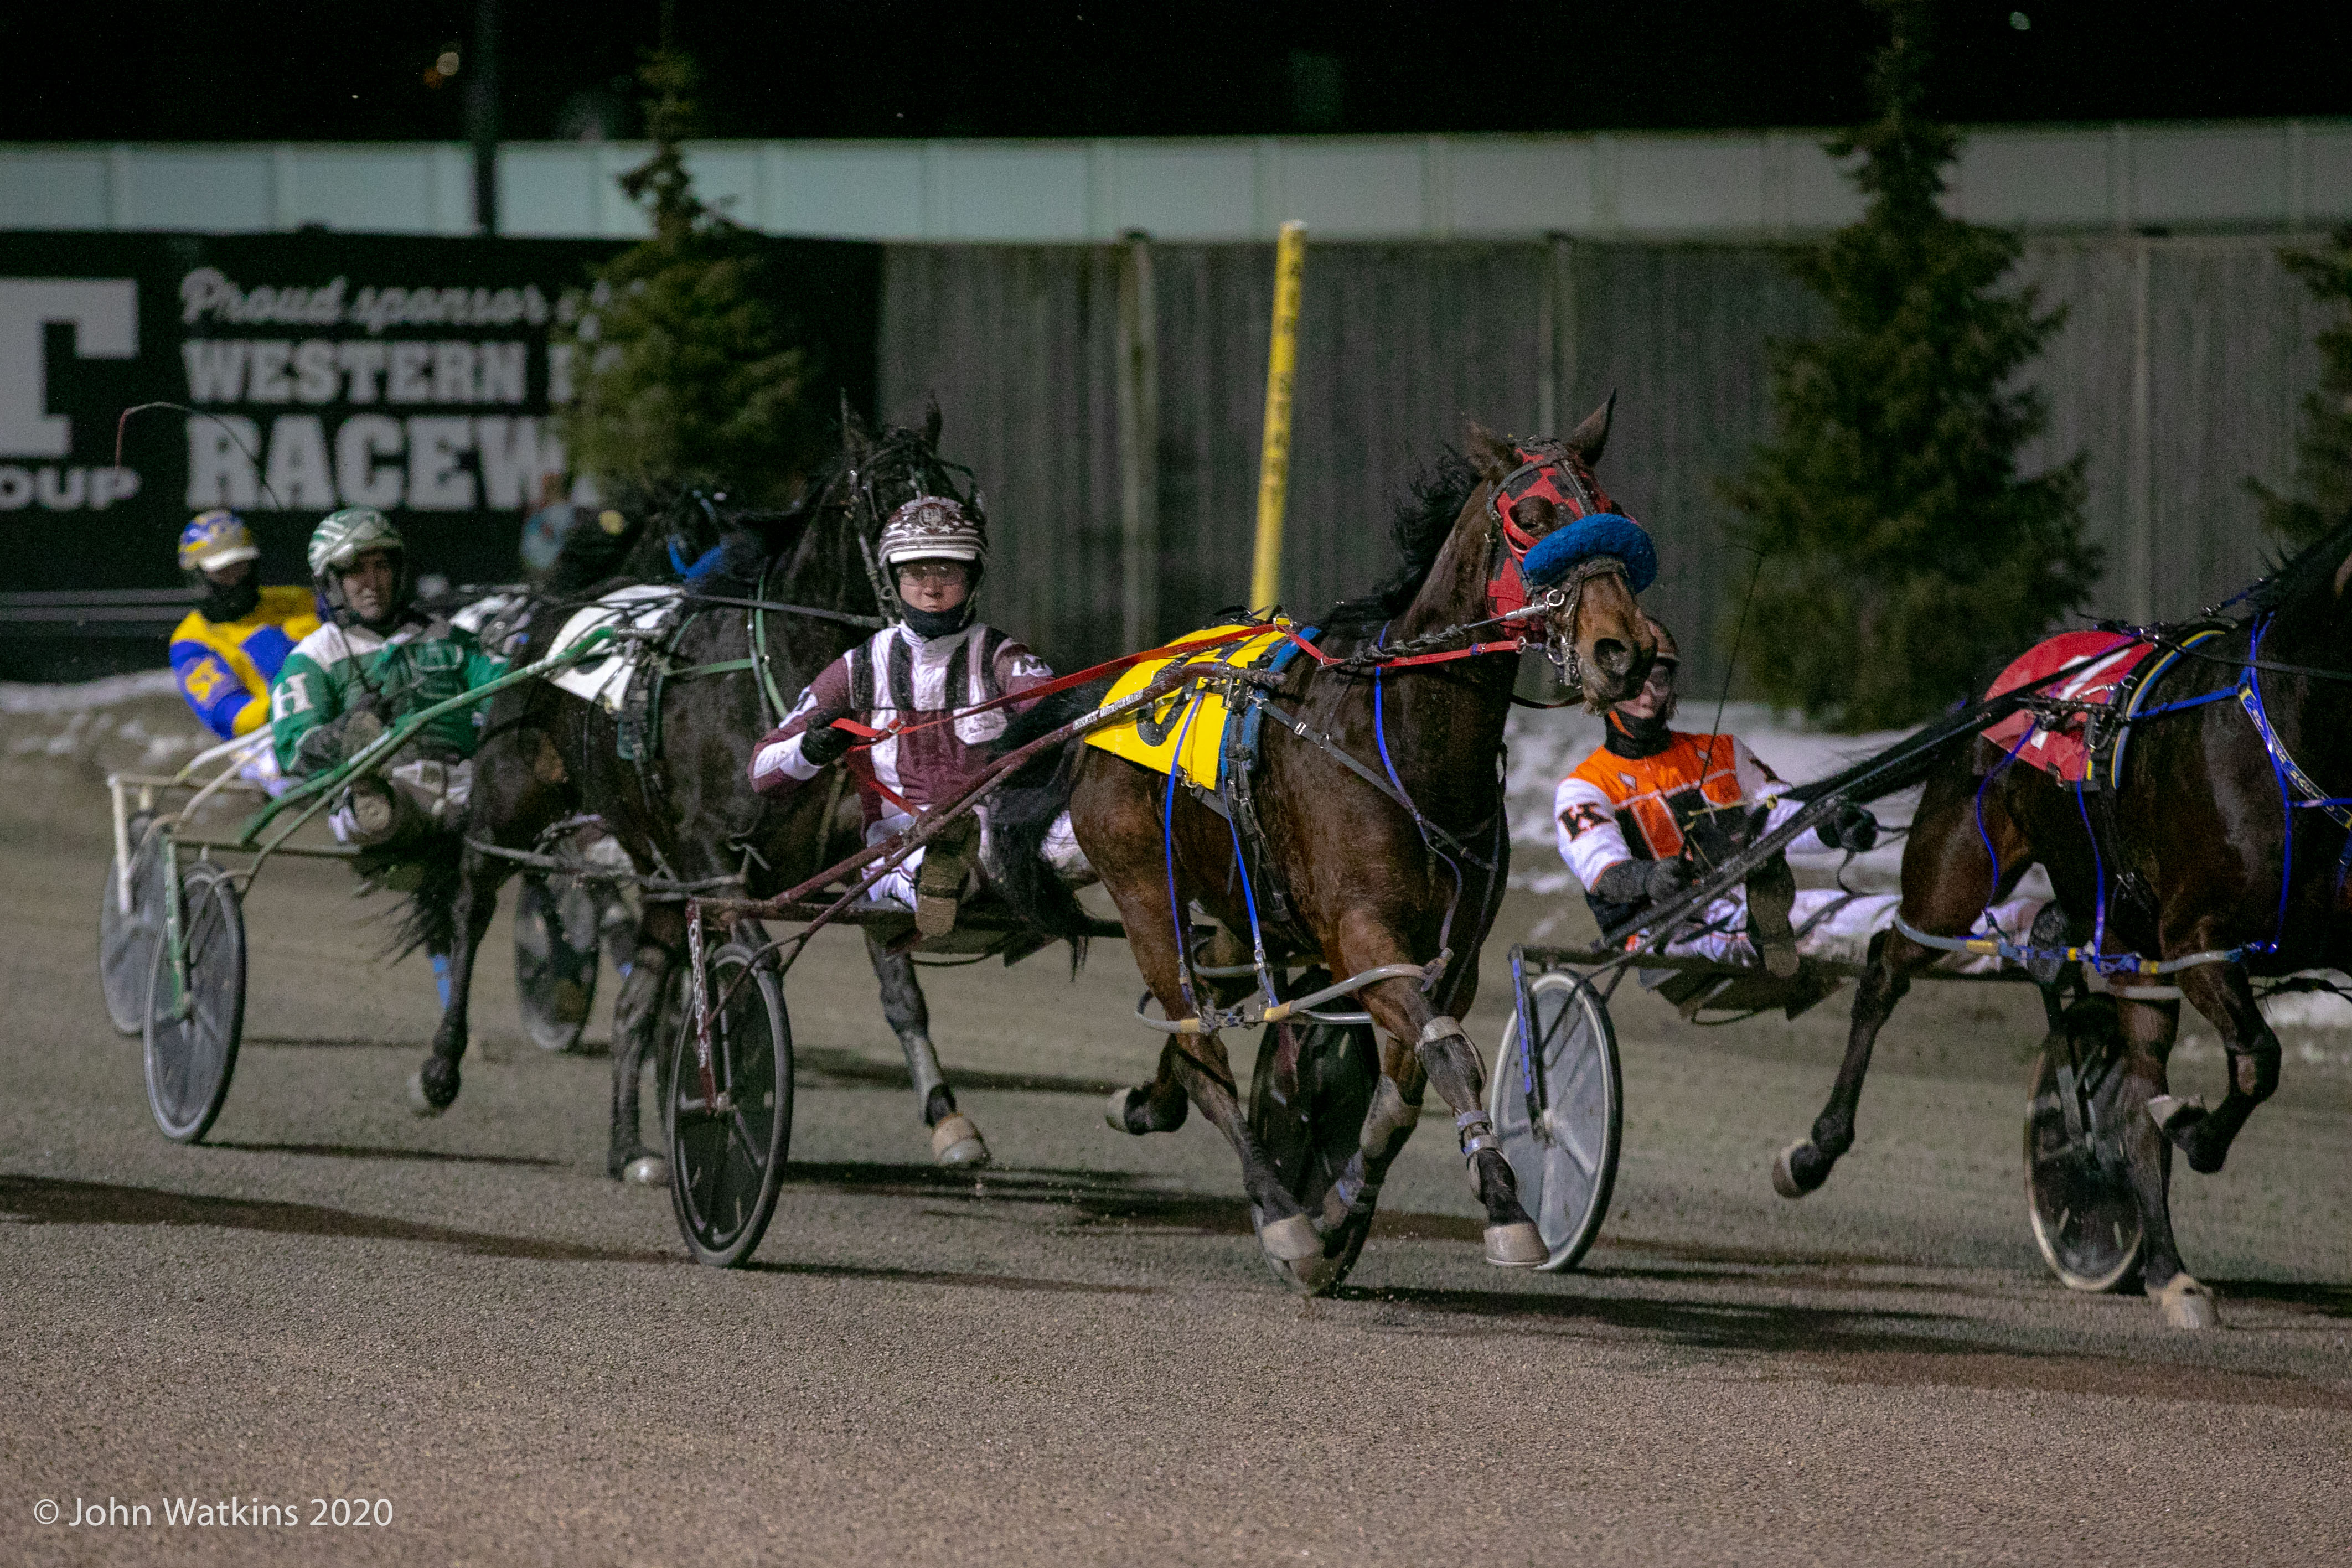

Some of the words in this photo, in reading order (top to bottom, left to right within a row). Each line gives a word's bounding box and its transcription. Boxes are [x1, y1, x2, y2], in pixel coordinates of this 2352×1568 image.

[180, 267, 348, 325] Proud
[351, 284, 549, 334] sponsor
[182, 339, 528, 405] WESTERN
[272, 673, 314, 722] H
